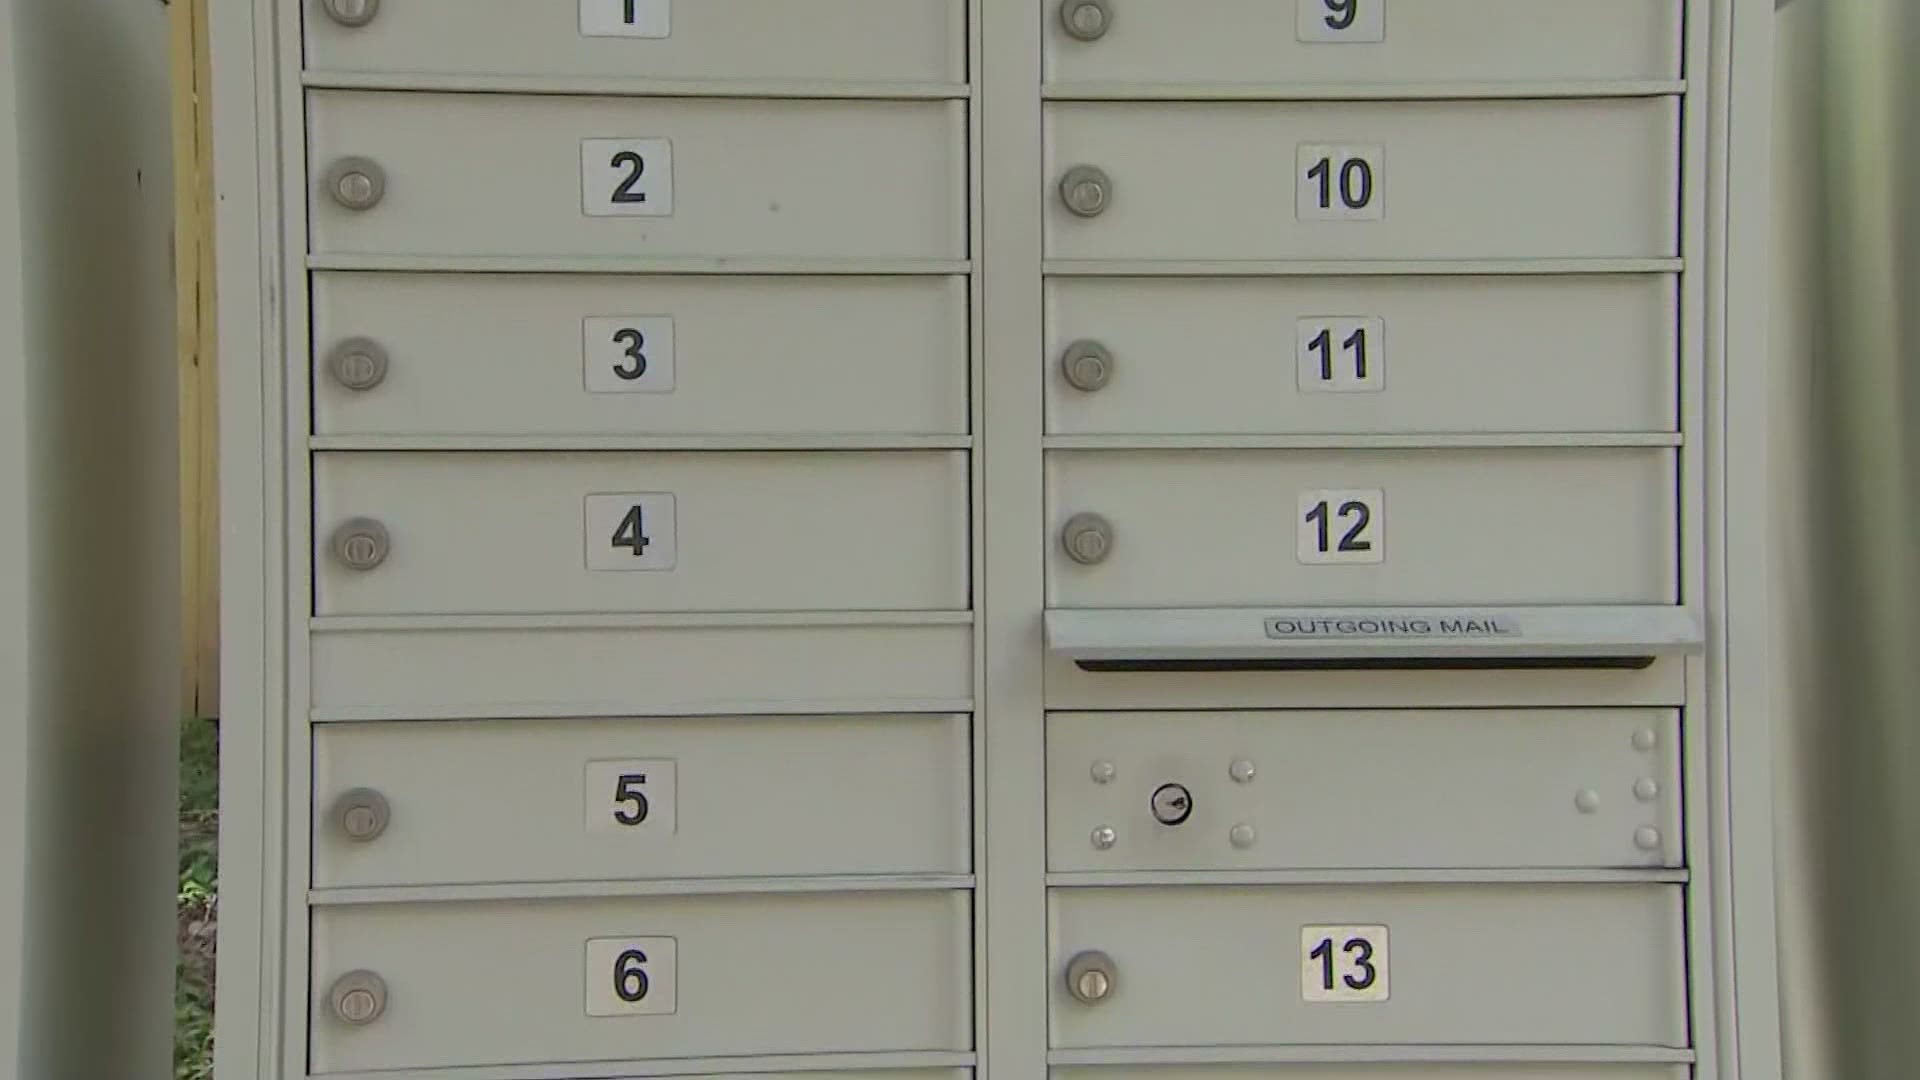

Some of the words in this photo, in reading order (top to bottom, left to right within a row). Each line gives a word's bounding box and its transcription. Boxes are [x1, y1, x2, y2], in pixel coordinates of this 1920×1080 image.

[1324, 0, 1357, 30] 9
[610, 151, 646, 204] 2
[1307, 156, 1373, 210] 10
[612, 328, 647, 381] 3
[1307, 327, 1367, 381] 11
[611, 504, 650, 557] 4
[1306, 500, 1372, 553] 12
[1275, 619, 1431, 634] OUTGOING
[1440, 619, 1509, 634] MAIL
[613, 774, 649, 827] 5
[613, 949, 649, 1003] 6
[1310, 937, 1376, 991] 13
